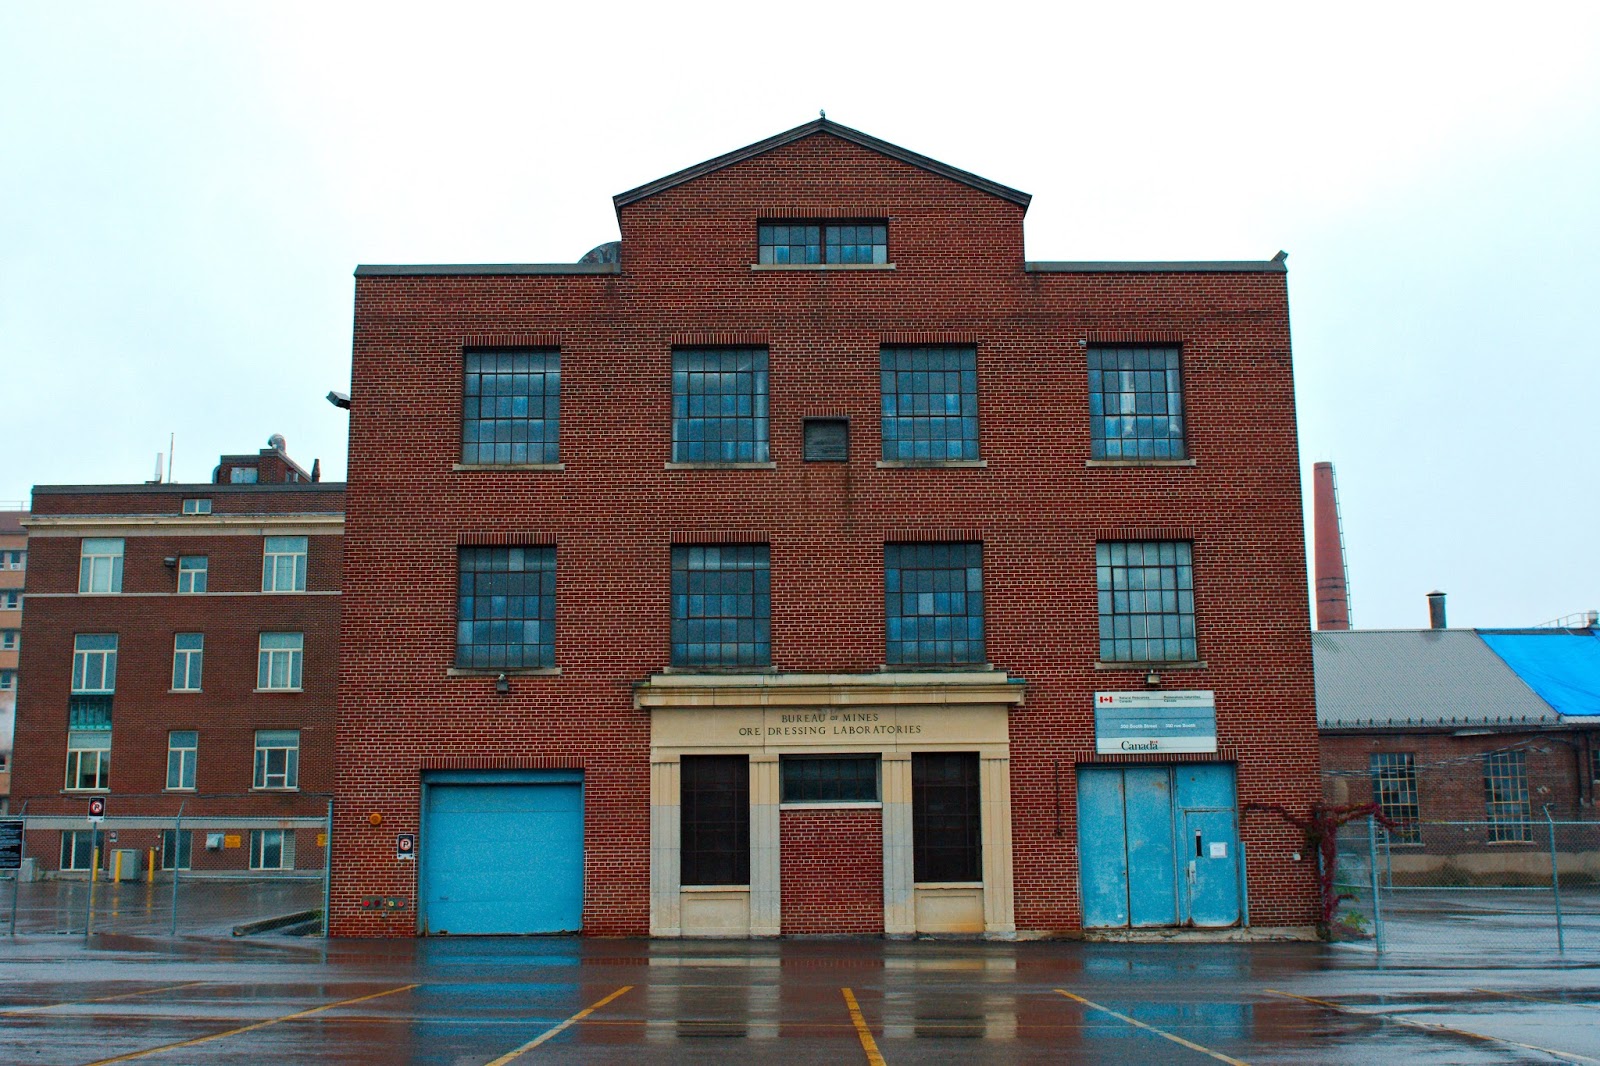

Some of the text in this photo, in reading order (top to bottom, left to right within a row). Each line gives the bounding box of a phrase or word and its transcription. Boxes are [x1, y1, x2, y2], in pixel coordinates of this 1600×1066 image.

[781, 714, 826, 723] BUREAU
[842, 713, 879, 722] MINES
[738, 725, 921, 736] ORE DRESSING LABORATORIES
[1121, 740, 1158, 751] Canada
